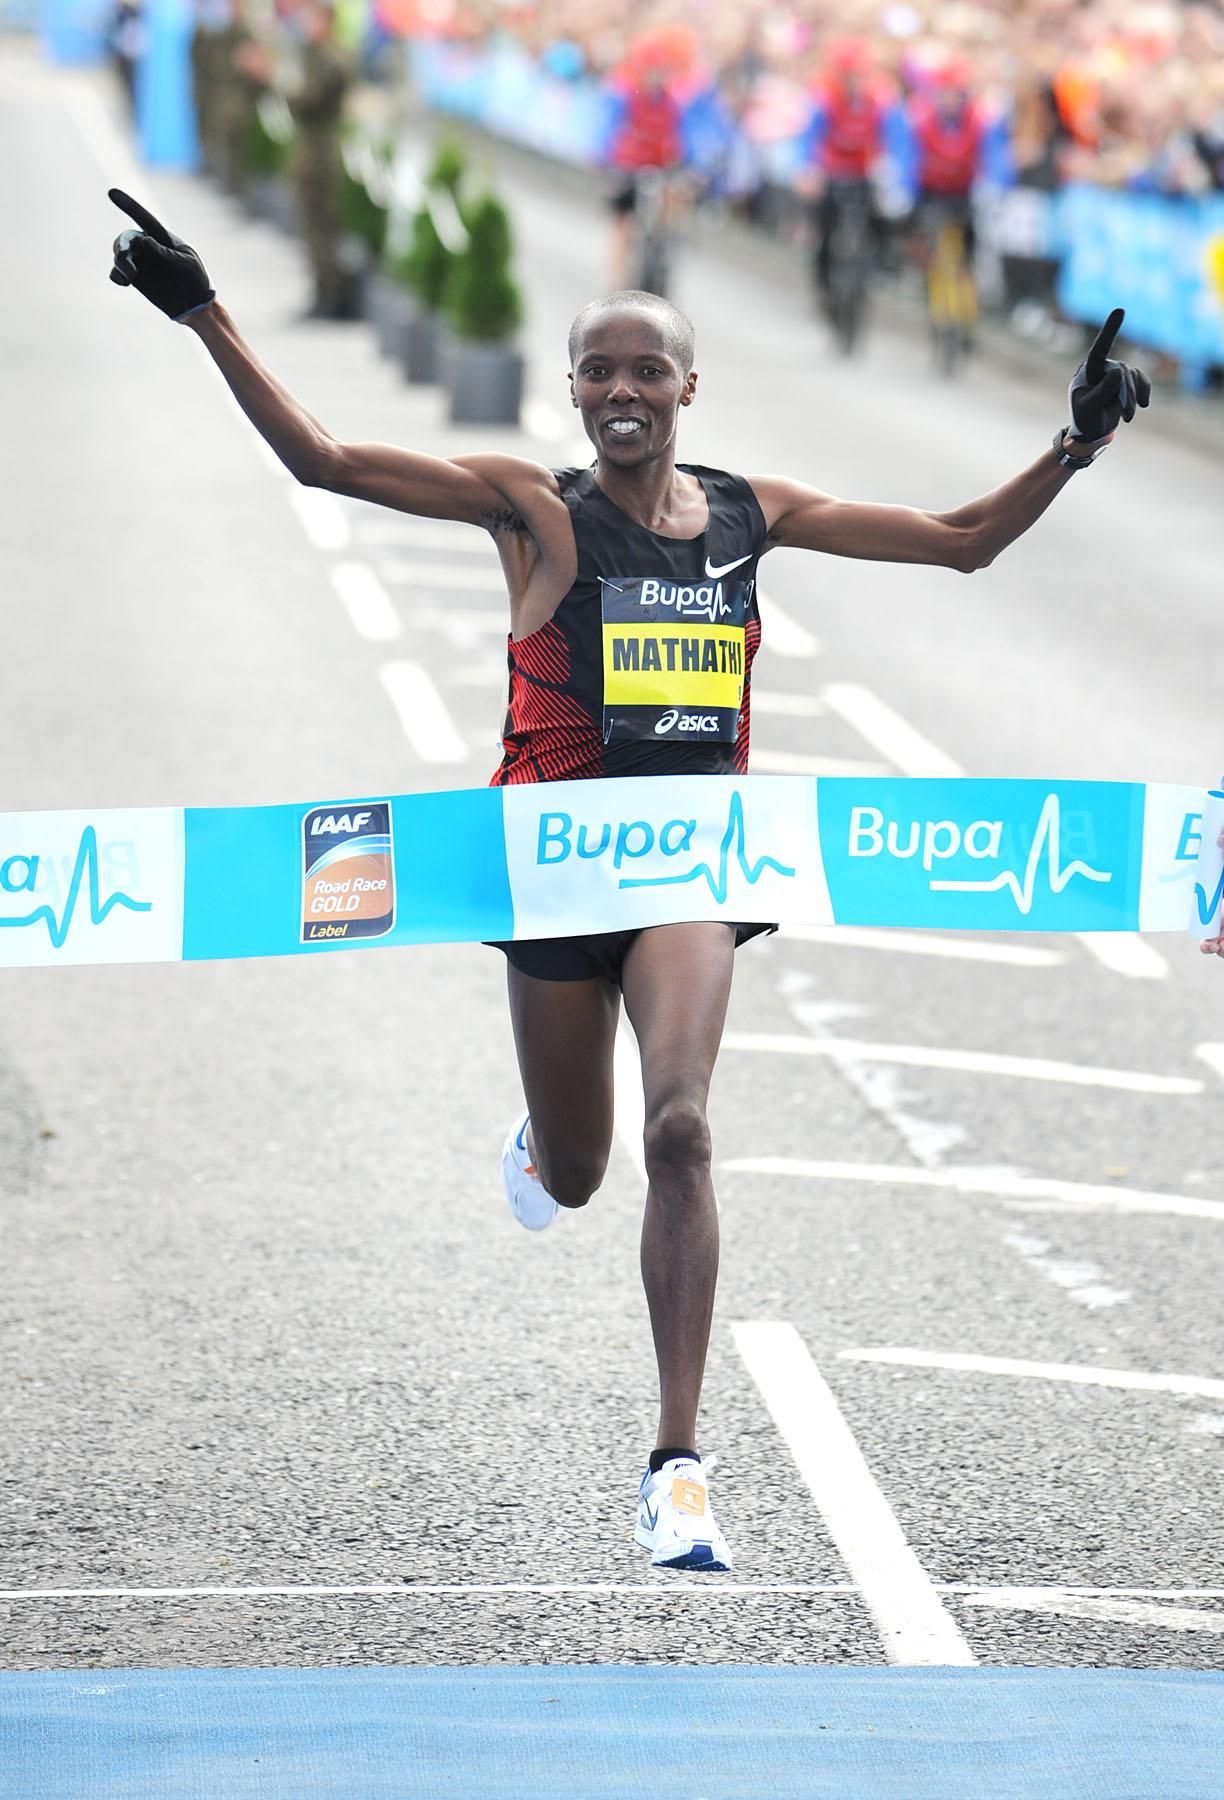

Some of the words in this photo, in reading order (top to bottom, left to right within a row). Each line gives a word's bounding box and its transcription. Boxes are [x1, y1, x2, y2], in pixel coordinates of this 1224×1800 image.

[640, 580, 714, 612] Bupa
[612, 638, 742, 675] MATHATHI
[310, 812, 372, 835] IAAF
[537, 812, 696, 869] Bupa
[848, 806, 1003, 871] Bupa
[314, 879, 351, 894] Road
[352, 877, 387, 892] Race
[310, 895, 360, 913] GOLD
[309, 923, 348, 938] Label
